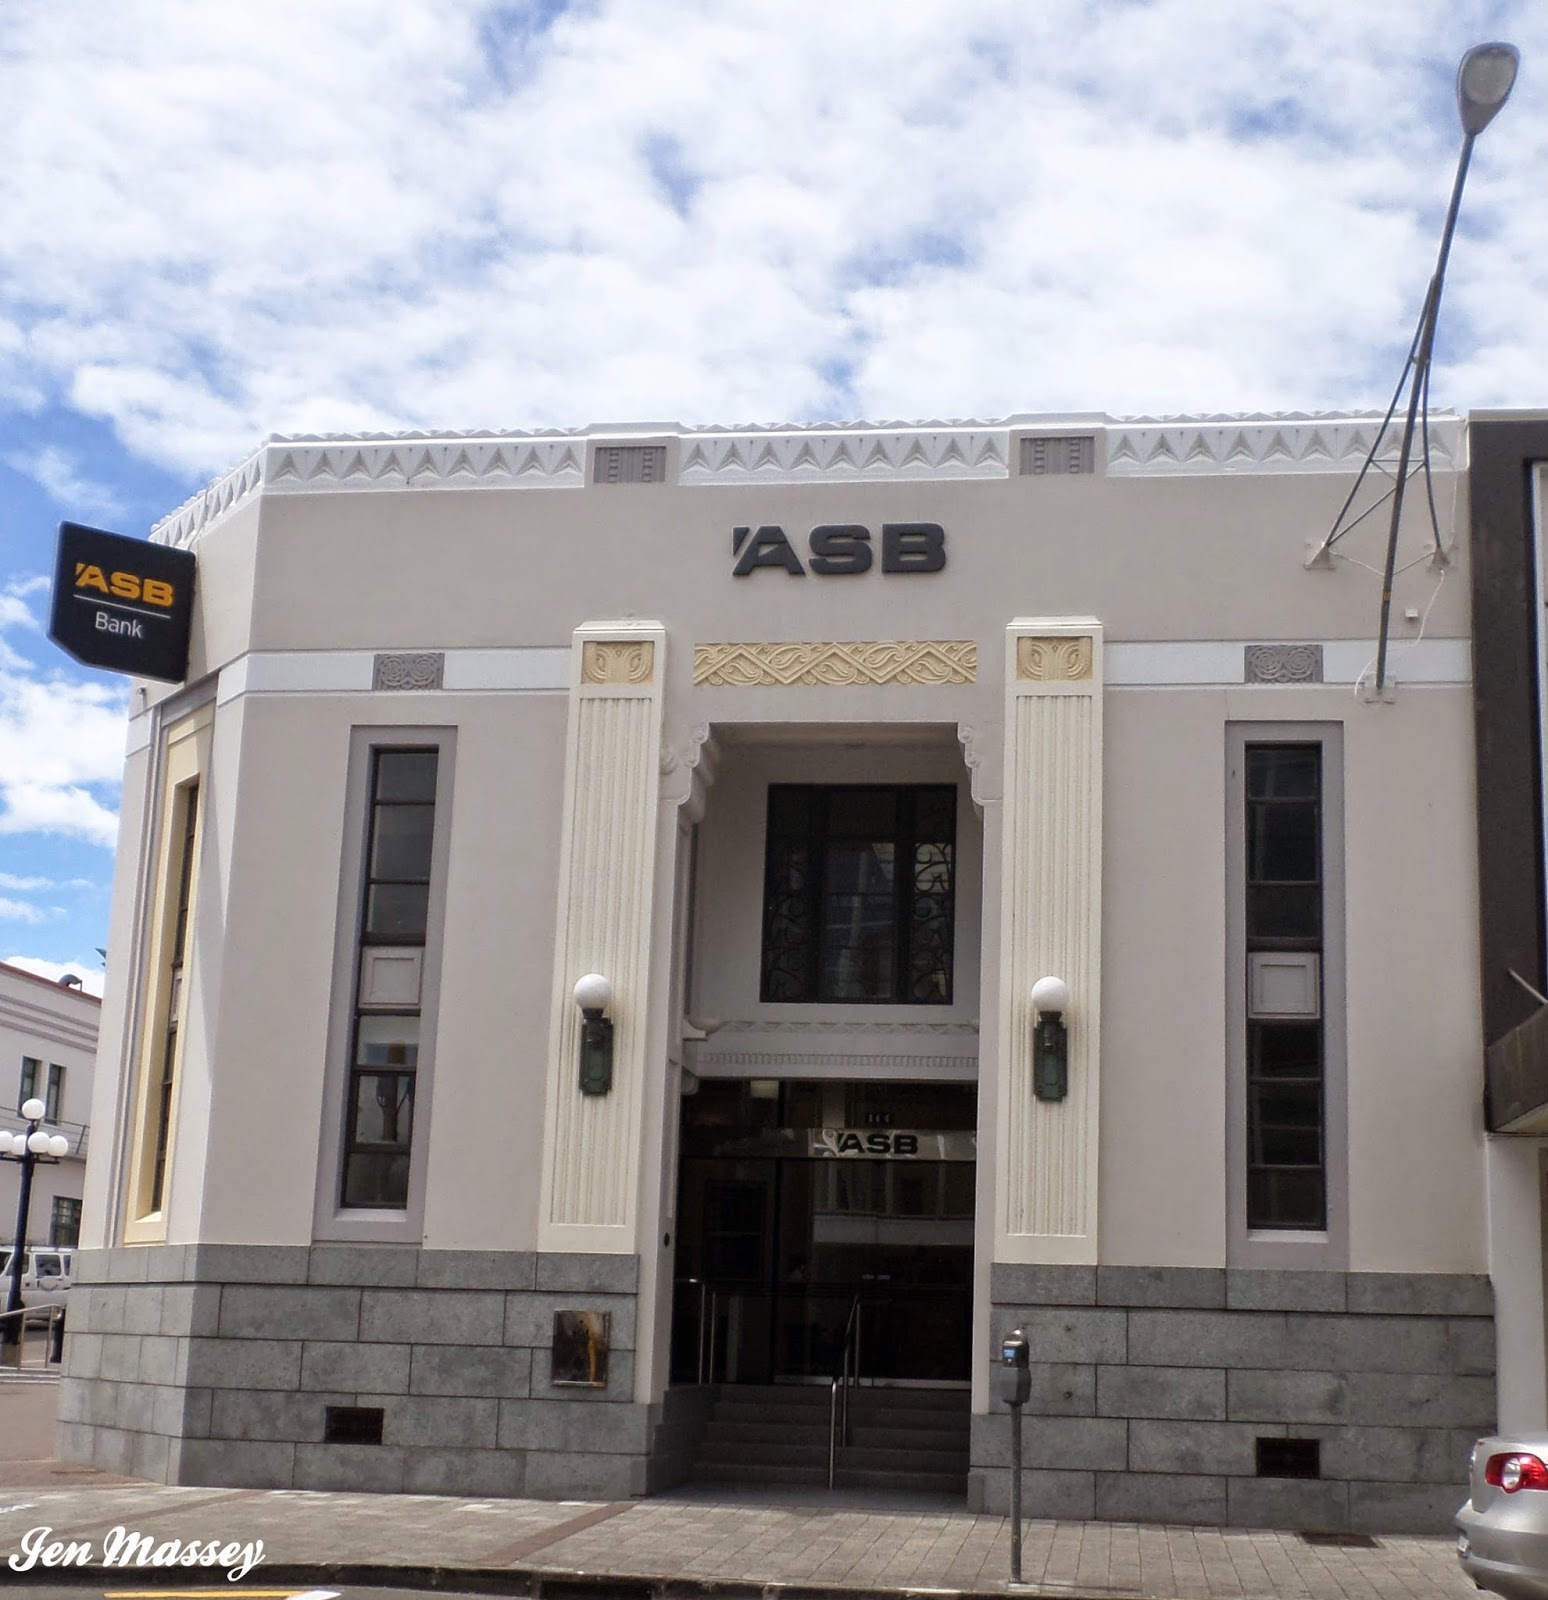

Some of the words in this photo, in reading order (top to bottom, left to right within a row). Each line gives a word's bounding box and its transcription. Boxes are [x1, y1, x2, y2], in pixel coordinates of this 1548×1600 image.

[732, 523, 946, 576] ASB
[75, 562, 174, 607] ASB
[95, 611, 143, 638] Bank
[837, 1133, 919, 1155] ASB
